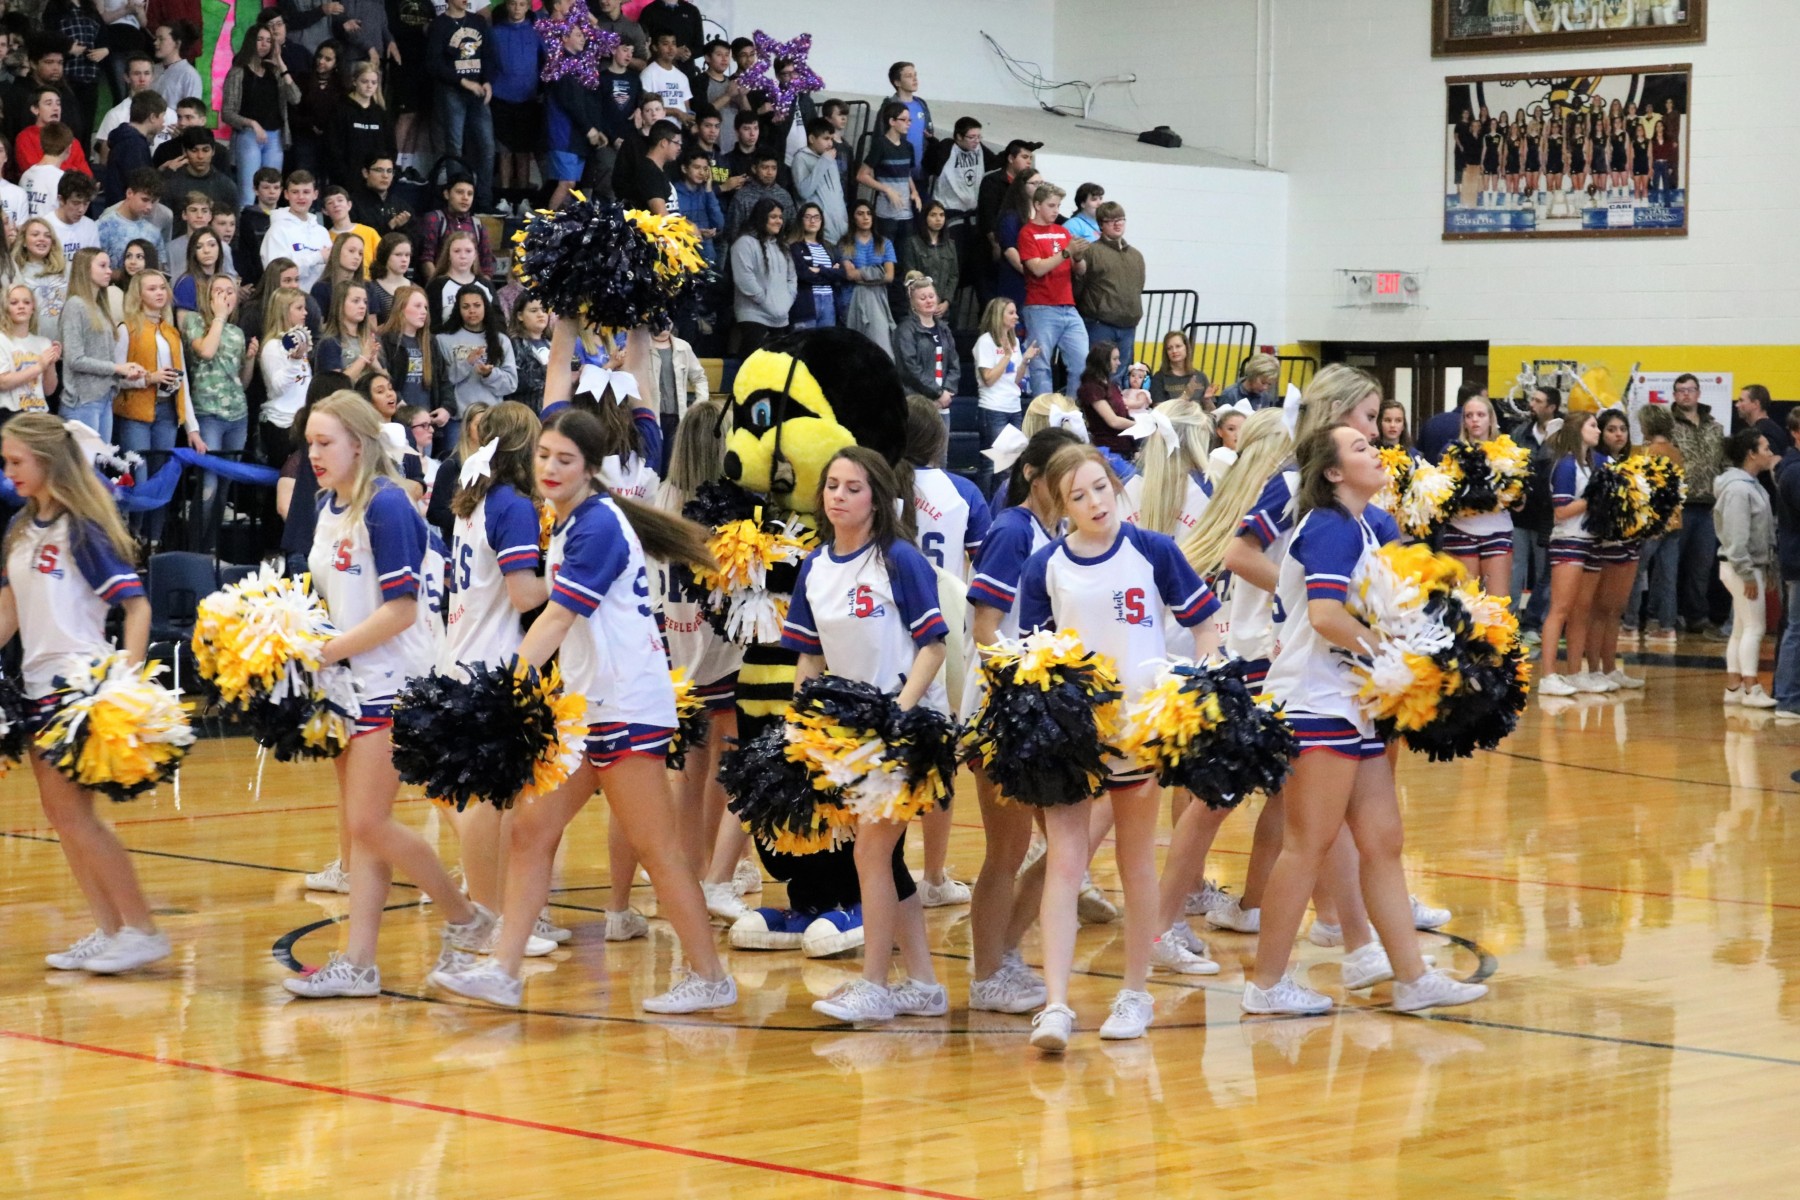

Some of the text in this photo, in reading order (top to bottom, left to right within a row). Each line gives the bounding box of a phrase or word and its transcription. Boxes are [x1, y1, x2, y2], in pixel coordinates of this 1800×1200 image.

[954, 151, 979, 168] ARMY
[1377, 273, 1400, 294] EXIT
[38, 544, 60, 574] S
[335, 538, 354, 571] S
[856, 585, 873, 618] S
[1125, 587, 1145, 625] S
